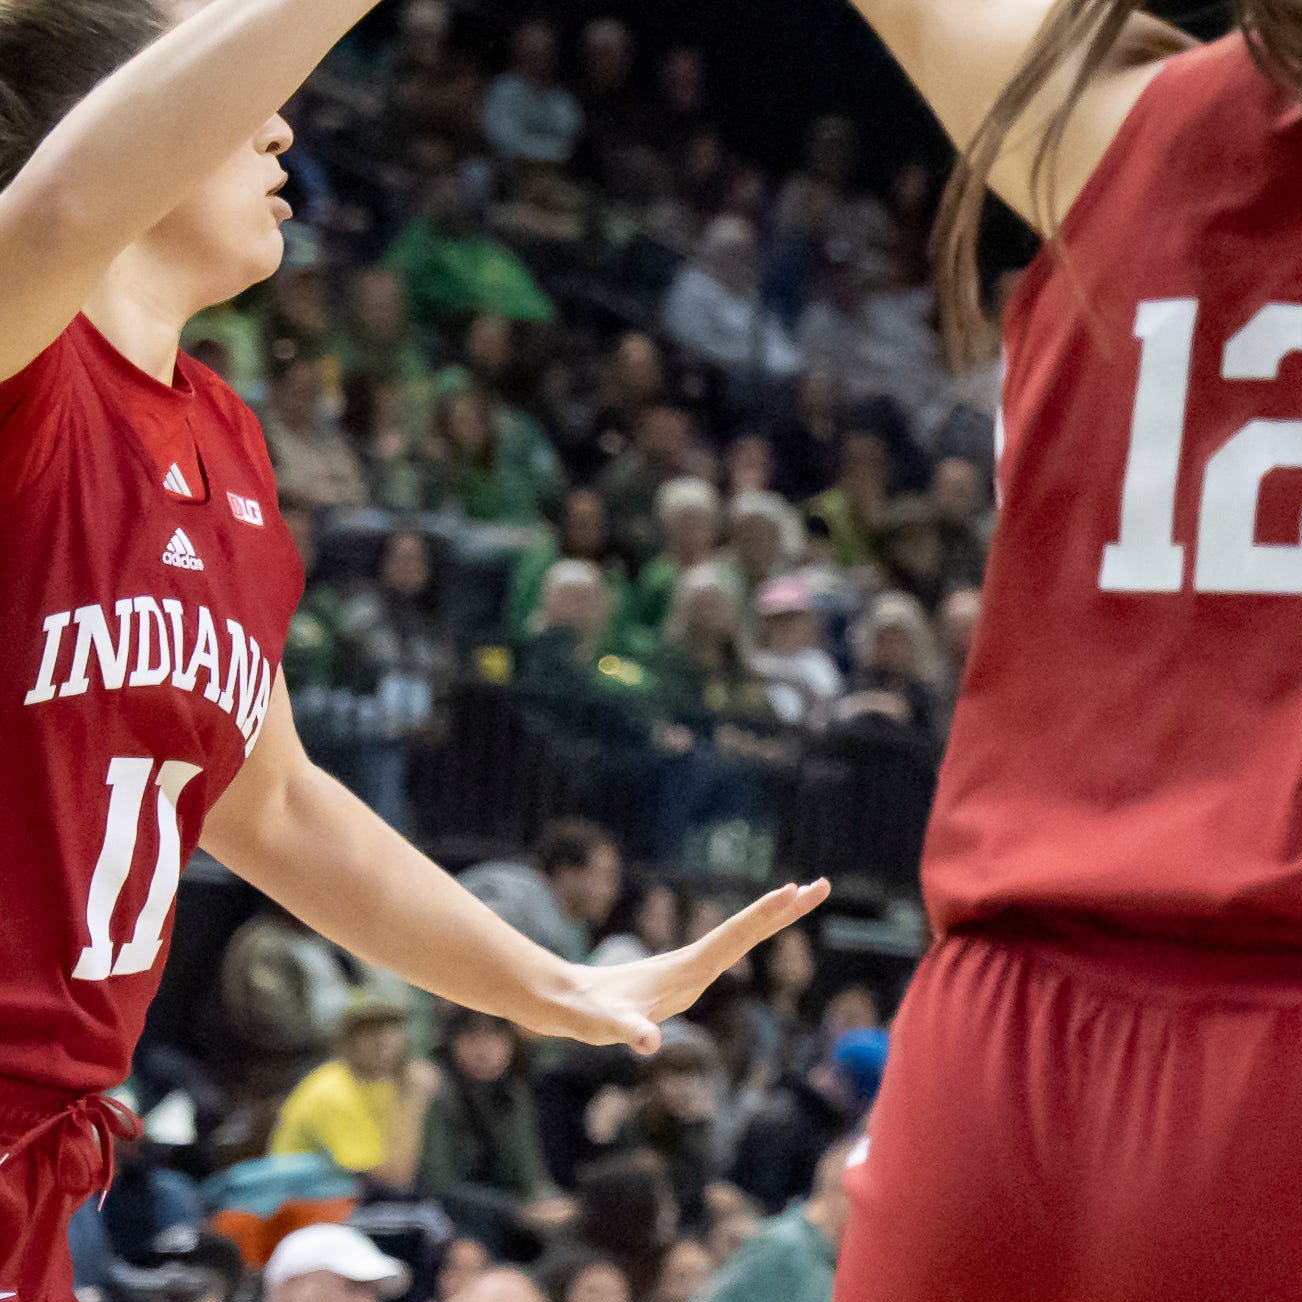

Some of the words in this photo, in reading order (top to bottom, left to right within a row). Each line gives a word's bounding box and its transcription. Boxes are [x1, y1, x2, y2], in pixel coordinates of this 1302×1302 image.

[162, 551, 204, 571] adidas
[23, 596, 271, 758] INDIANA
[71, 756, 203, 980] 11
